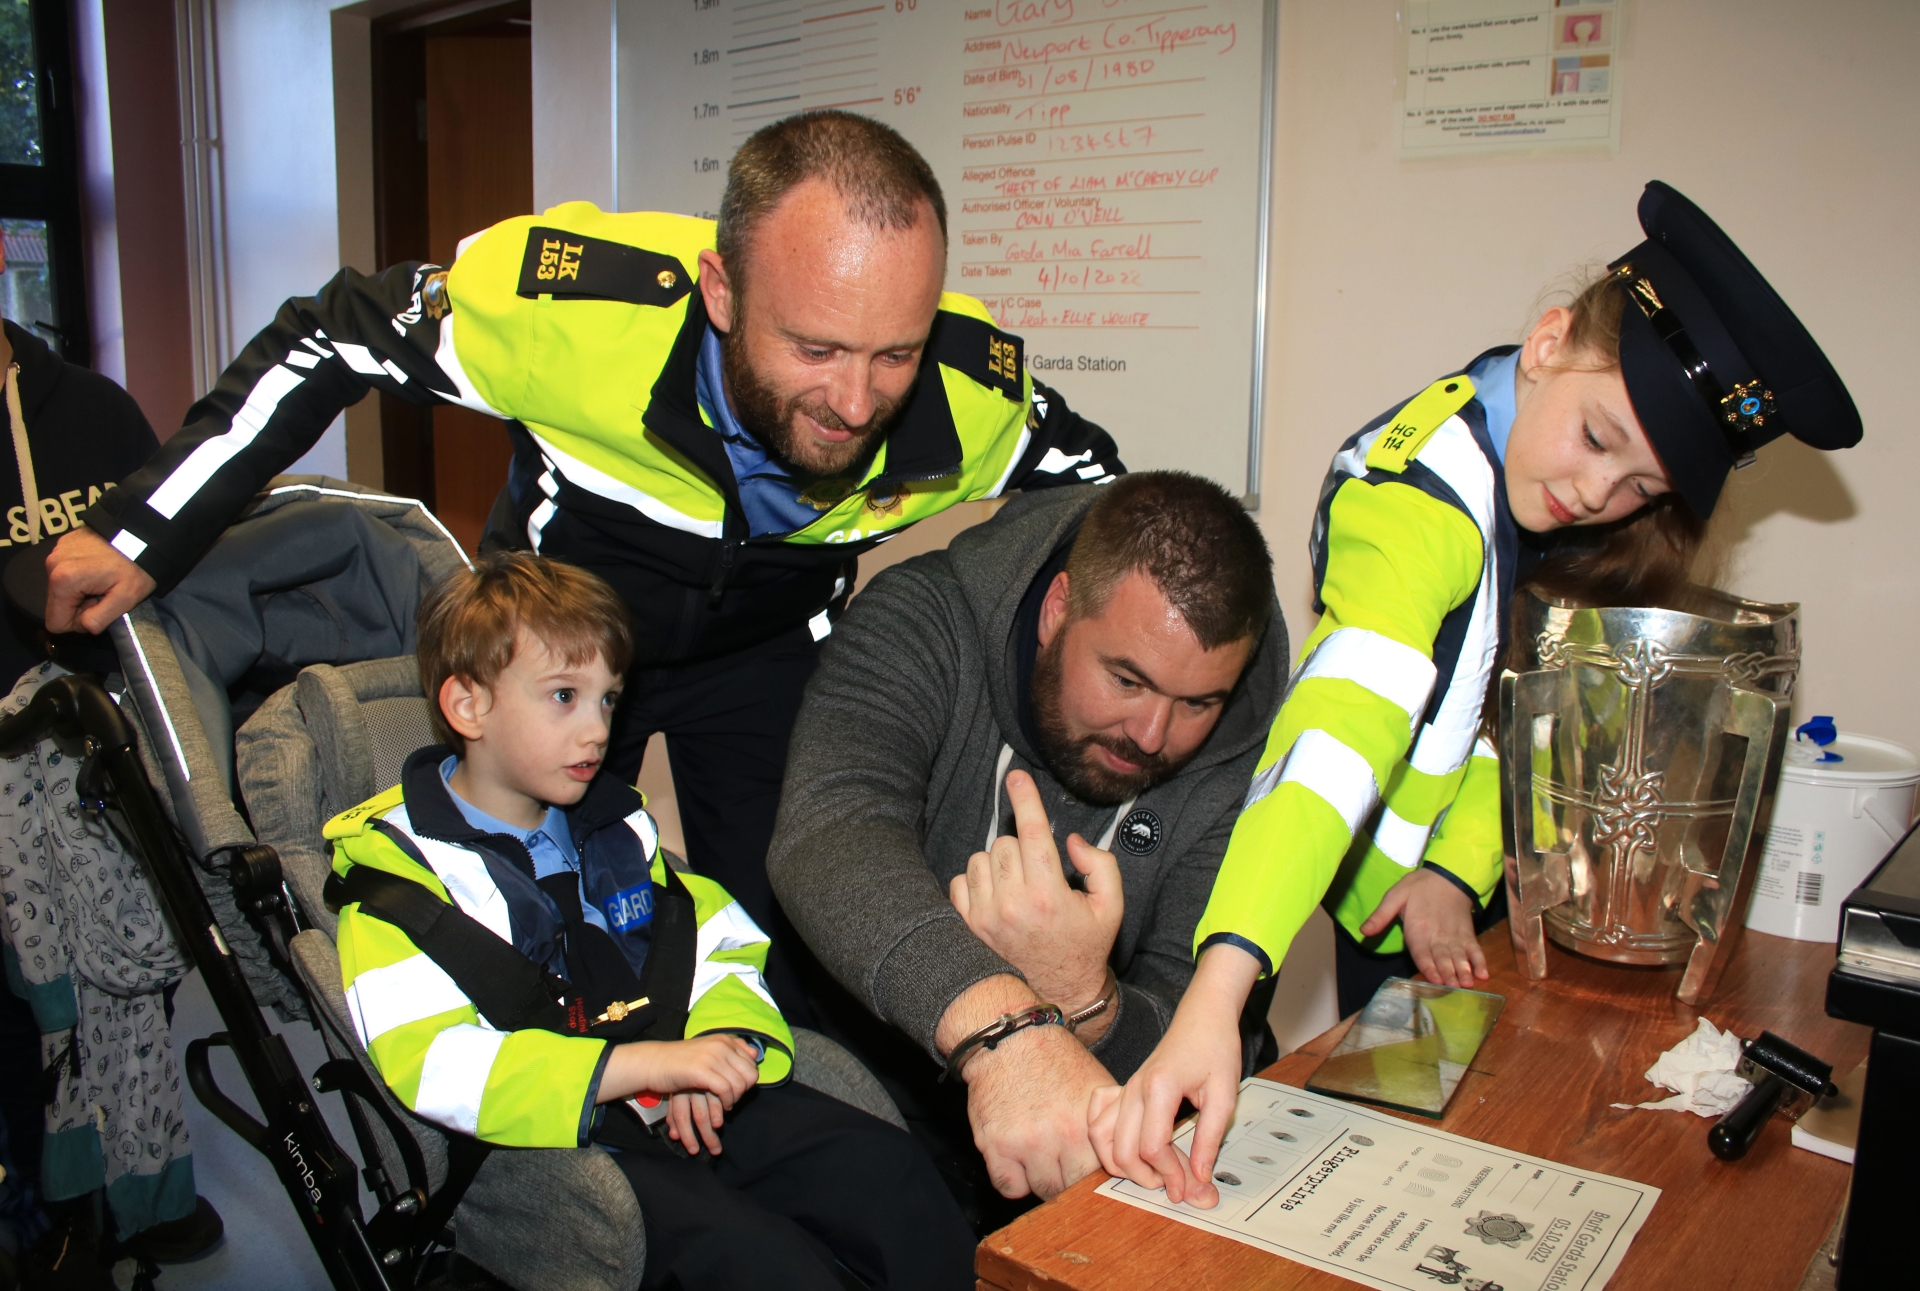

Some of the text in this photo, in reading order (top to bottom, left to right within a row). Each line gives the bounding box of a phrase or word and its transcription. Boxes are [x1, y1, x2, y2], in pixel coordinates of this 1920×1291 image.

[964, 9, 992, 21] Name
[964, 40, 1002, 53] Address
[693, 50, 719, 65] 1.8m
[963, 69, 1022, 87] Date of Birth
[694, 104, 719, 119] 1.7m
[963, 103, 1012, 118] Nationality
[962, 132, 1036, 150] Person Pulse ID
[694, 159, 719, 174] 1.6m
[962, 166, 1036, 183] Alleged Offence
[994, 178, 1037, 197] THEFT
[1043, 176, 1061, 191] OF
[1188, 167, 1219, 183] CUP
[962, 201, 1011, 213] Authorised
[1013, 198, 1045, 212] Officer
[1053, 196, 1100, 211] Voluntary
[962, 233, 1002, 247] Taken By
[1005, 233, 1152, 262] Garda Mia Farrell
[537, 239, 559, 280] 153
[557, 243, 584, 280] LK
[961, 265, 1012, 278] Date Taken
[1017, 297, 1042, 309] Case
[1061, 309, 1096, 325] ELLIE
[989, 335, 1003, 375] LK
[1003, 342, 1016, 382] 153
[1032, 355, 1073, 370] Garda
[1077, 355, 1127, 371] Station
[1391, 423, 1417, 438] HG
[1383, 436, 1405, 451] 114
[568, 1005, 577, 1028] Stop
[575, 997, 588, 1033] Houdini
[1411, 1147, 1424, 1155] loop
[284, 1132, 322, 1204] kimba
[1280, 1146, 1360, 1211] Fingerprints
[1382, 1176, 1393, 1186] arch
[1451, 1166, 1493, 1208] FINGERPRINT PATTERNS
[1343, 1202, 1360, 1214] just
[1373, 1205, 1387, 1213] No
[1333, 1213, 1350, 1223] like
[1362, 1213, 1377, 1224] one
[1324, 1223, 1337, 1233] me
[1379, 1218, 1401, 1238] special
[1415, 1222, 1428, 1231] am
[1347, 1230, 1362, 1240] the
[1395, 1231, 1420, 1251] special,
[1530, 1219, 1571, 1263] 05.10.2022
[1328, 1241, 1352, 1257] world,
[1363, 1244, 1378, 1255] can
[1543, 1211, 1610, 1291] Bruff Garda Statio
[1356, 1254, 1371, 1262] be
